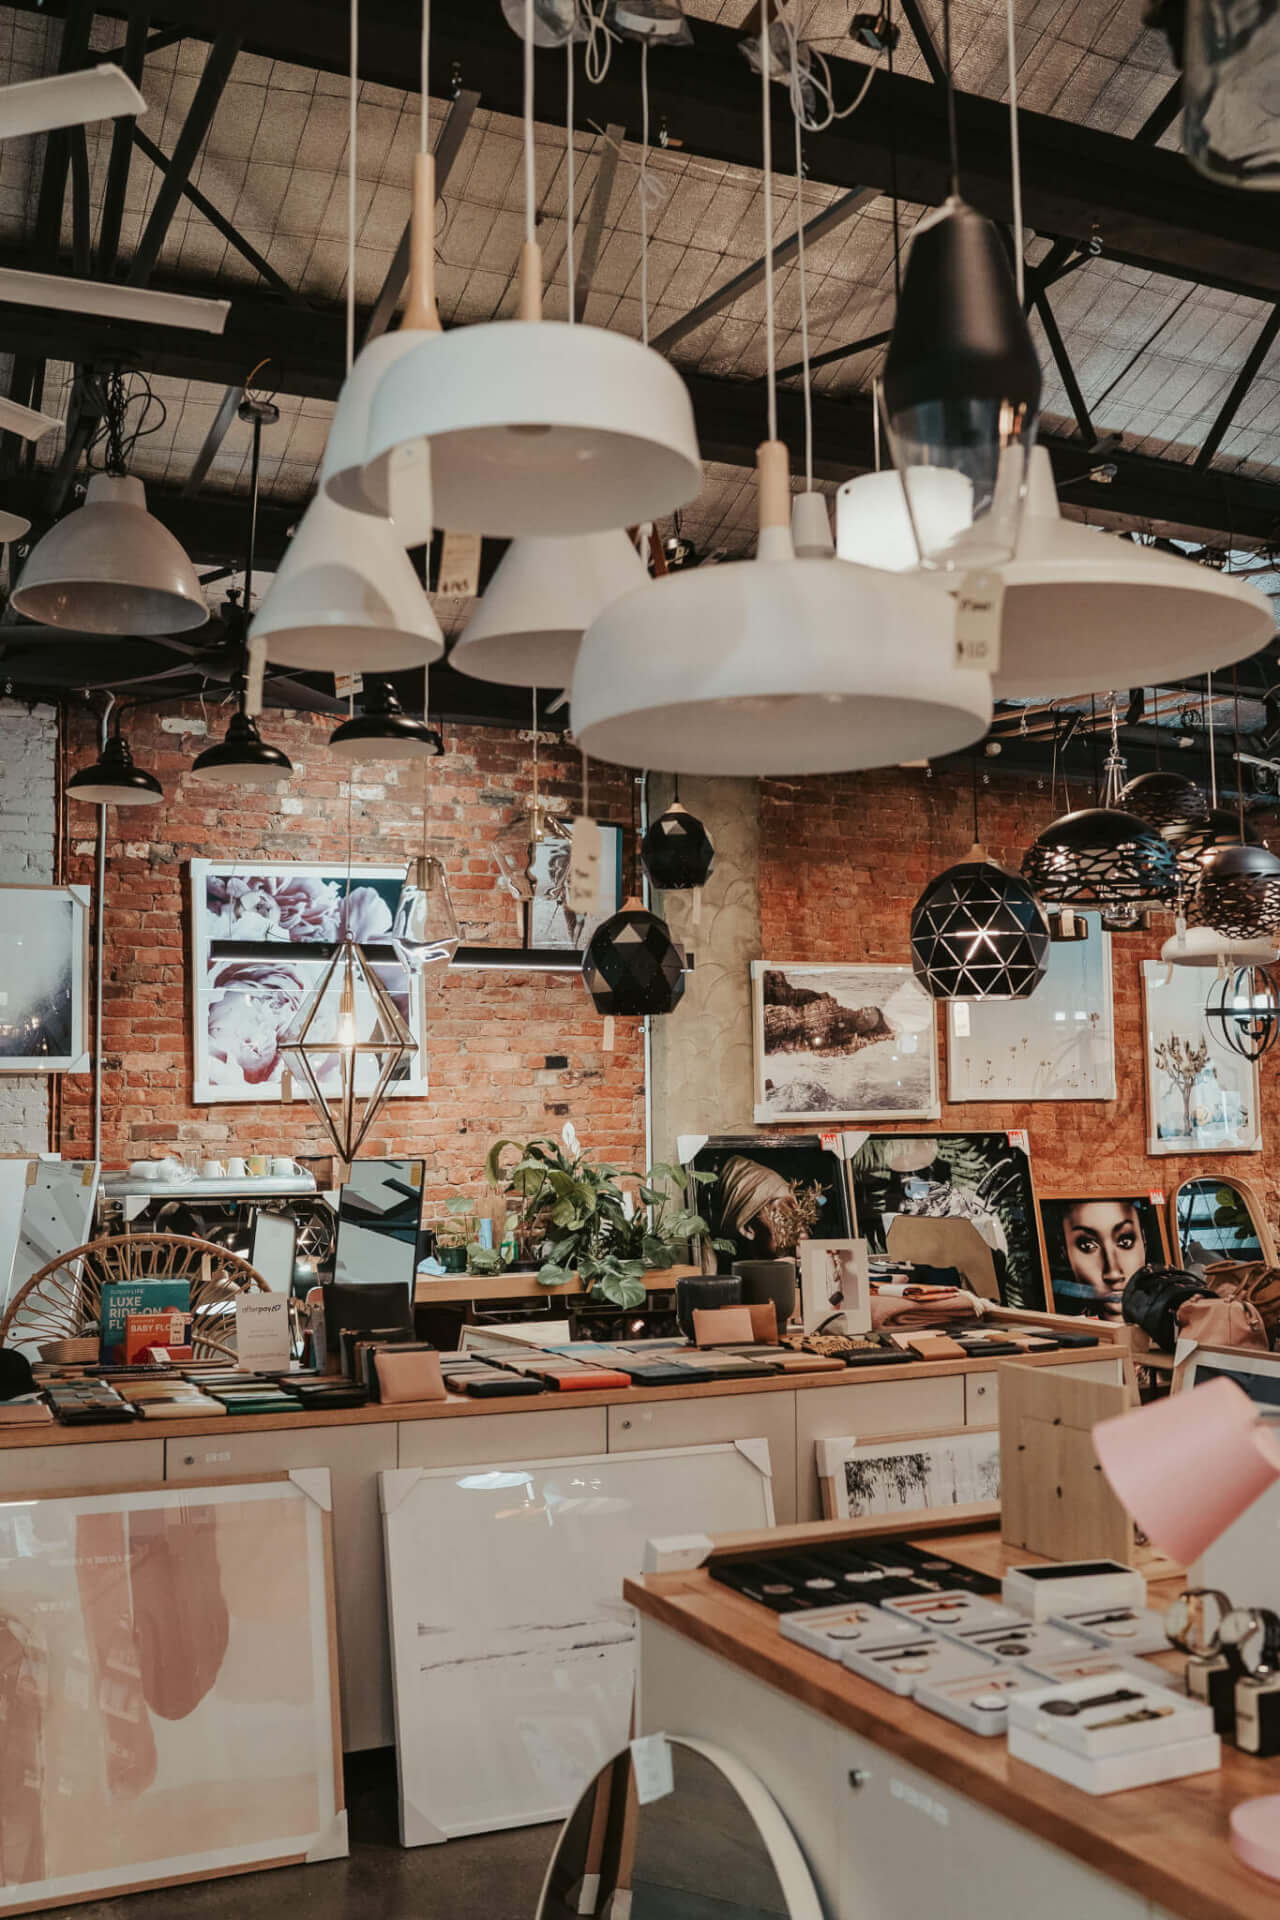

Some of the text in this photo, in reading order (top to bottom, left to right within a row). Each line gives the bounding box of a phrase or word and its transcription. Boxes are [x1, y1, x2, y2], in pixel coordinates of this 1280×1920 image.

[109, 1296, 142, 1307] LUXE
[109, 1307, 162, 1319] RIDE-ON
[109, 1320, 126, 1329] FL
